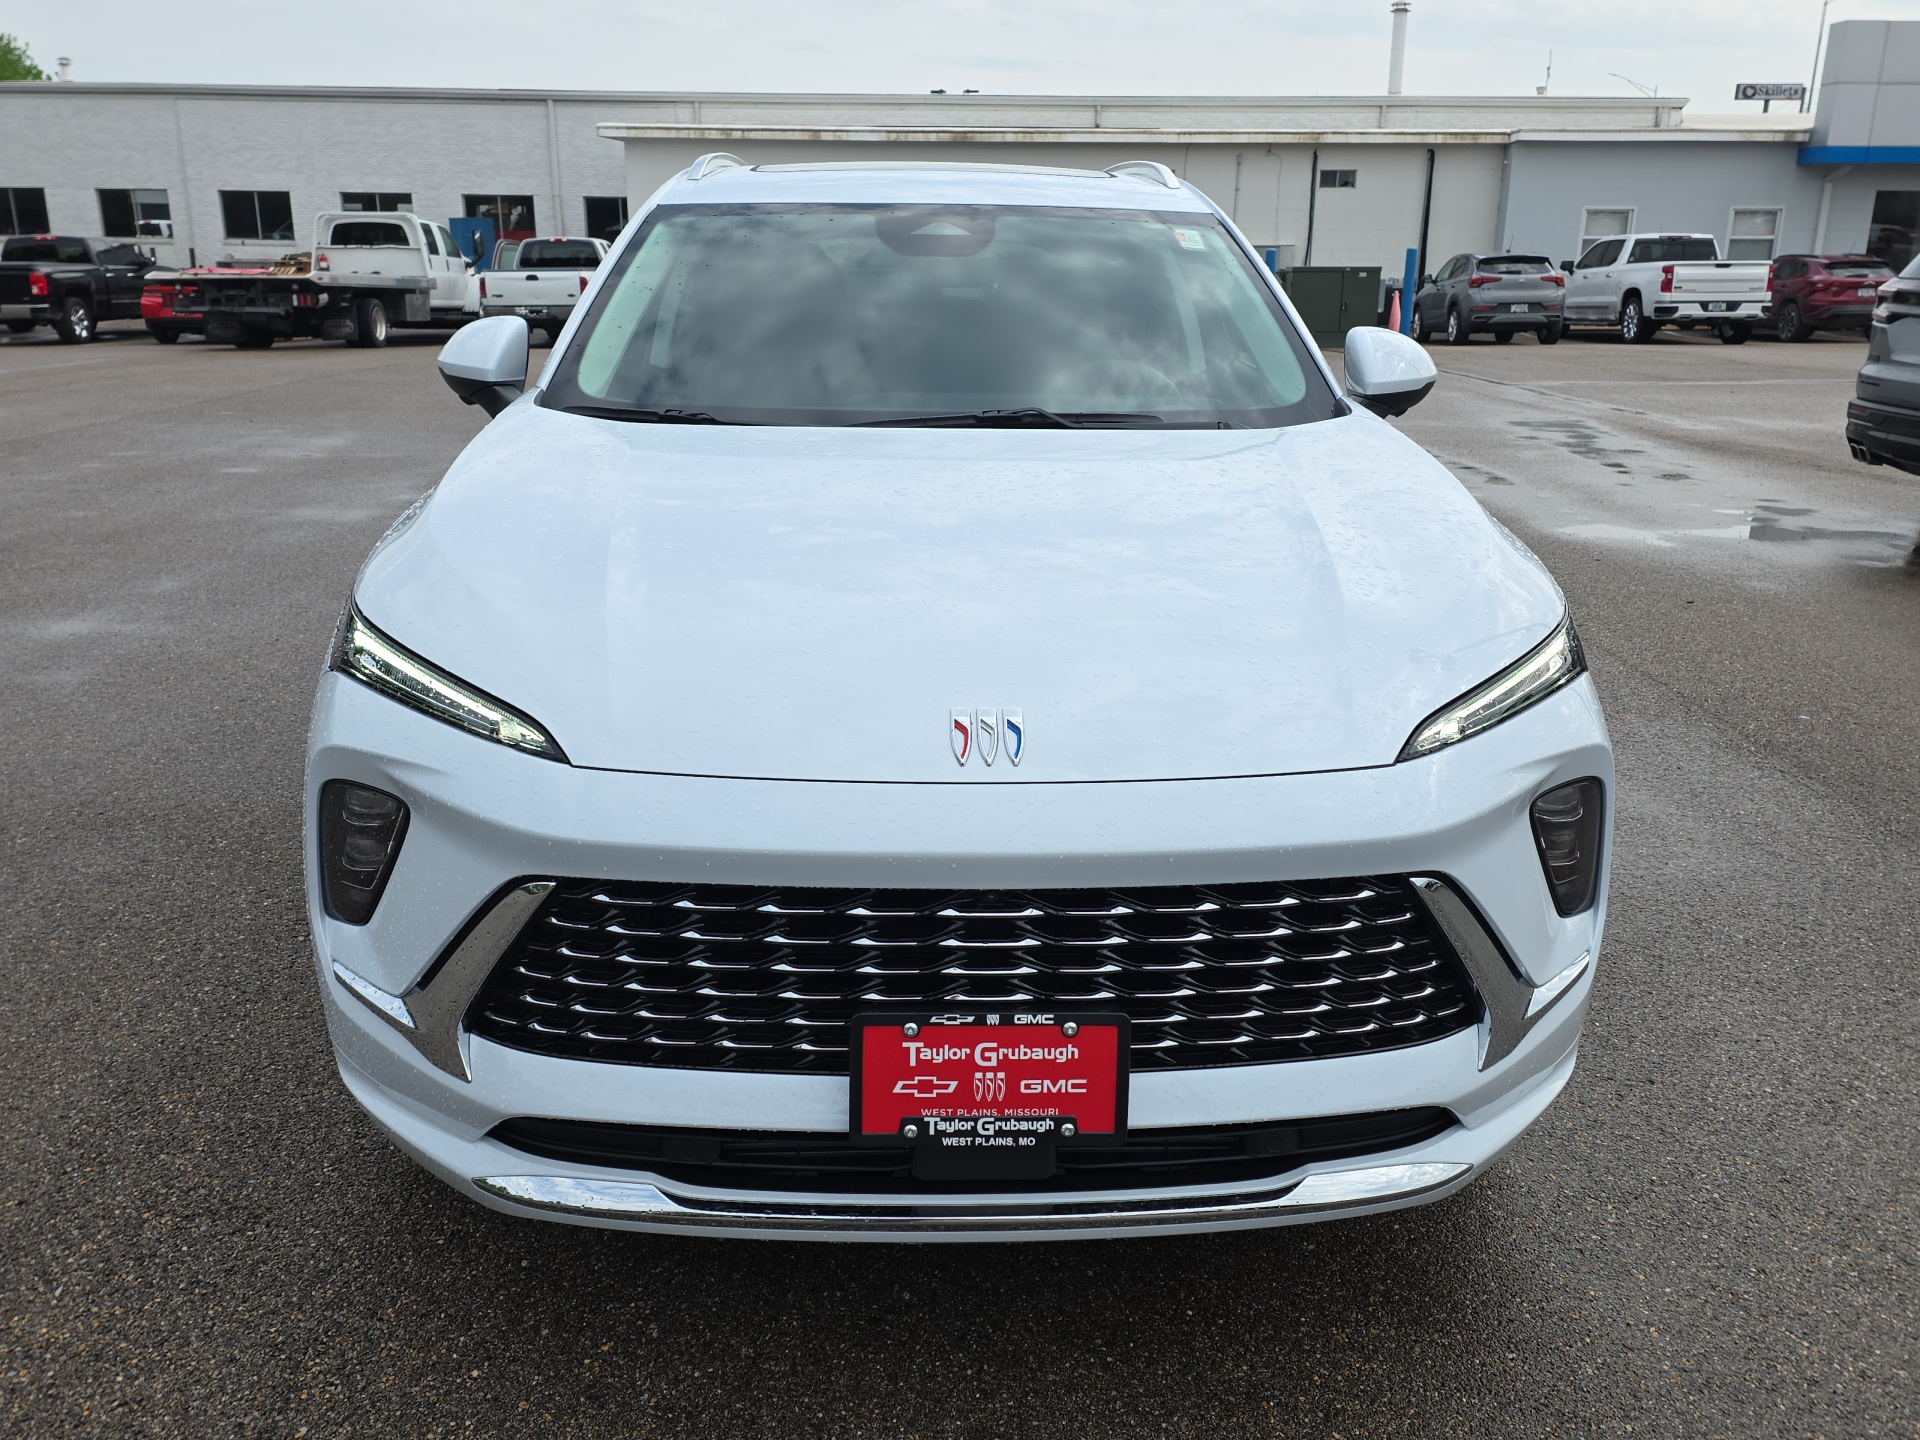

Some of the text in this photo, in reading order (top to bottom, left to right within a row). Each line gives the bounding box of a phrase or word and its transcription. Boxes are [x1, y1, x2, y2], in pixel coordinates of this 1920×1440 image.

[1757, 85, 1800, 97] Skillets
[1013, 1014, 1055, 1025] GMC
[902, 1041, 1079, 1067] Taylor Grubaugh
[1019, 1079, 1088, 1094] GMC
[920, 1108, 954, 1117] WEST
[1004, 1107, 1059, 1117] MISSOURI
[923, 1116, 1055, 1136] Taylor Grubaugh
[942, 1137, 1036, 1147] WEST PLAINS, MO
